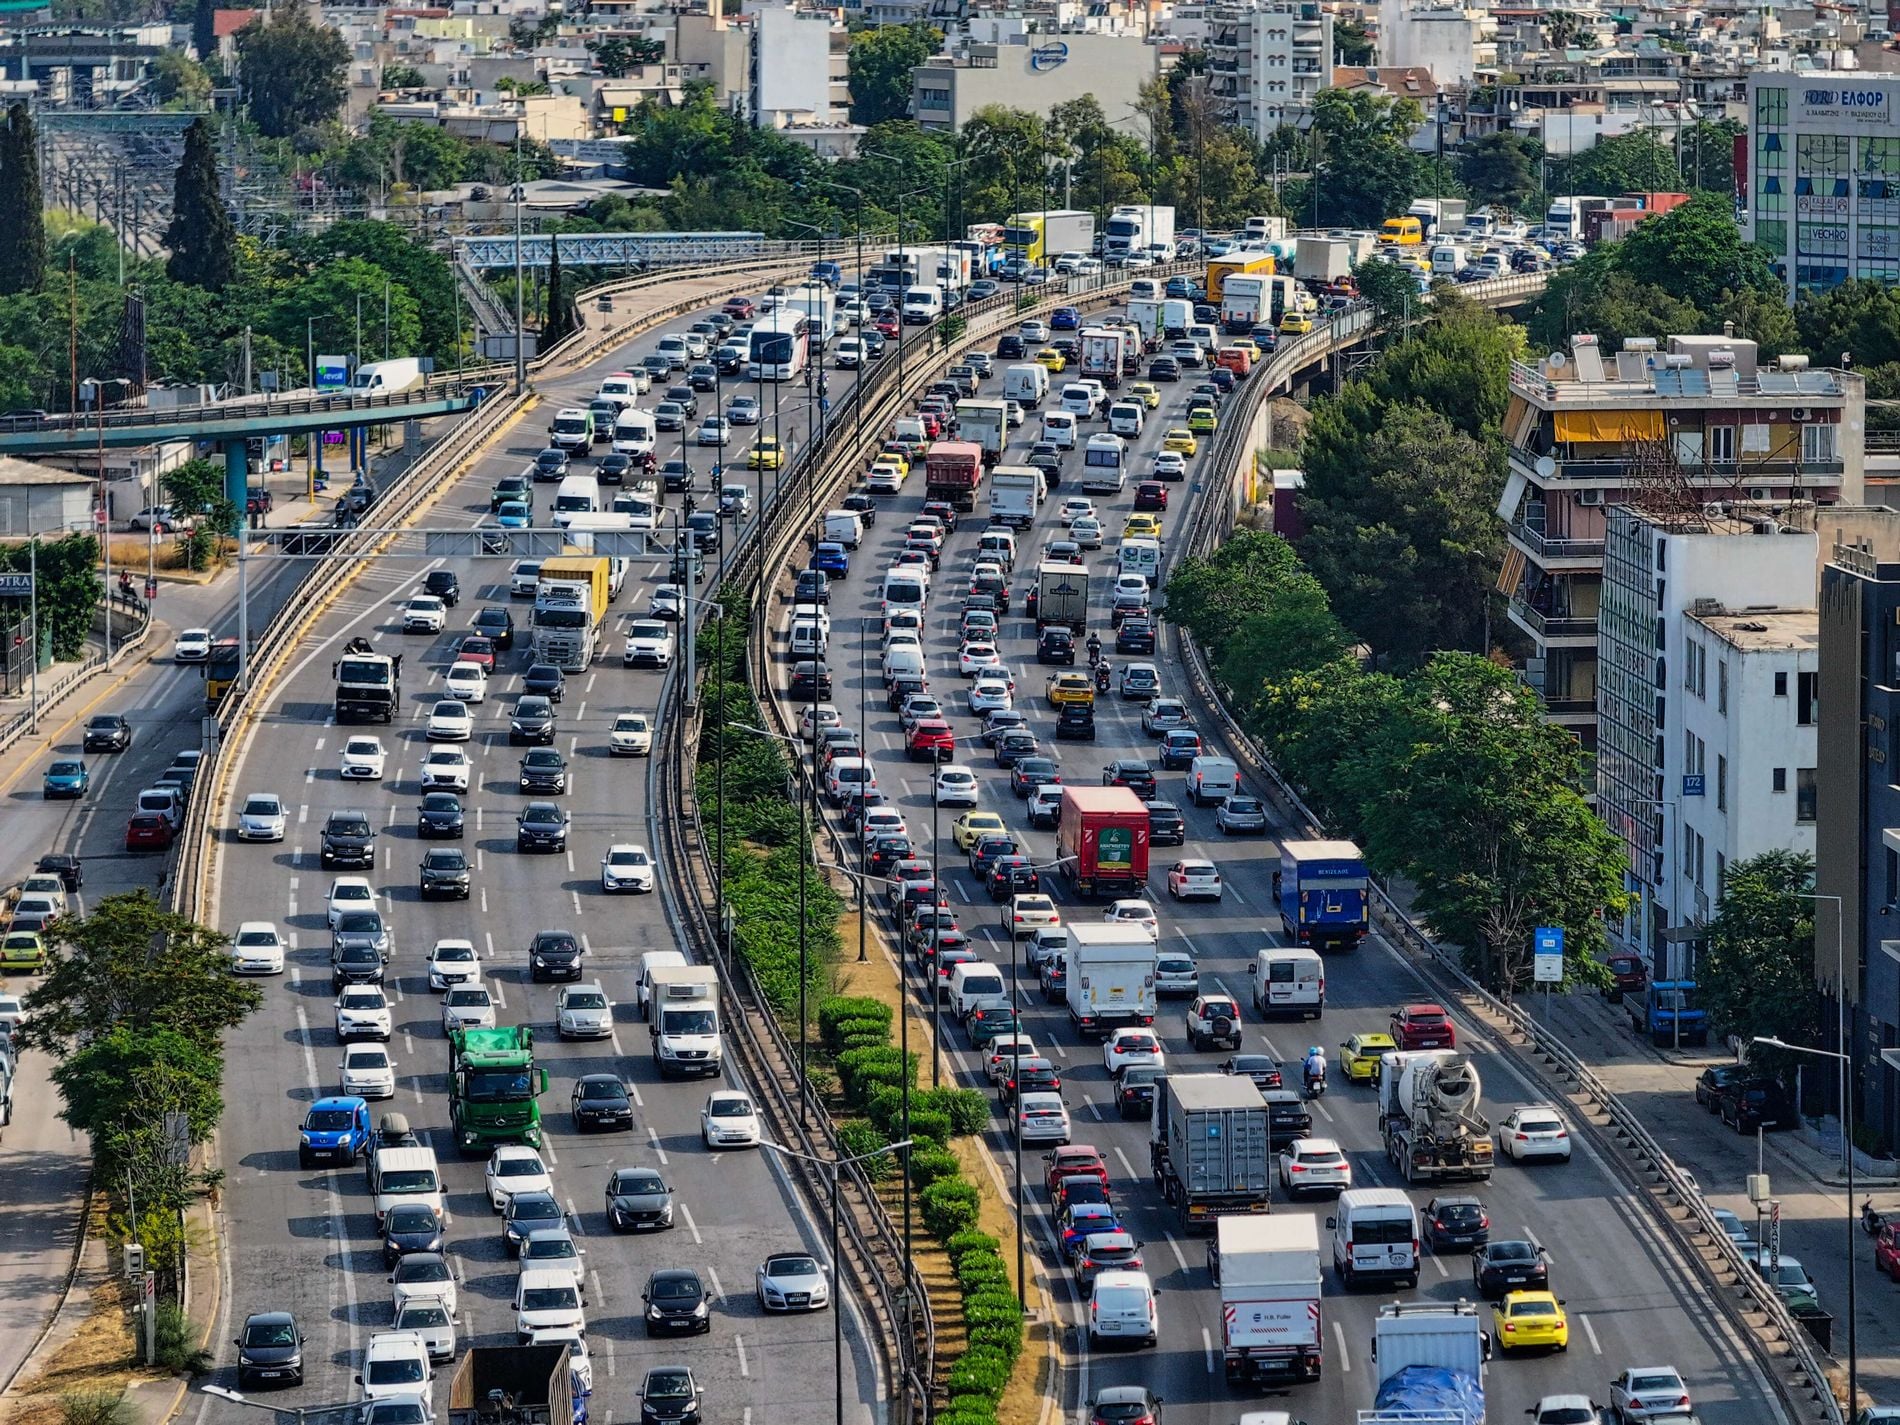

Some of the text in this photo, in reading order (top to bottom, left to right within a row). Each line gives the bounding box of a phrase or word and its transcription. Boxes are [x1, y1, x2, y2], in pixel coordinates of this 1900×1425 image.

[1841, 91, 1883, 106] ΕΛΦΟΡ
[1812, 229, 1847, 240] VECHRO
[1687, 777, 1701, 787] 172
